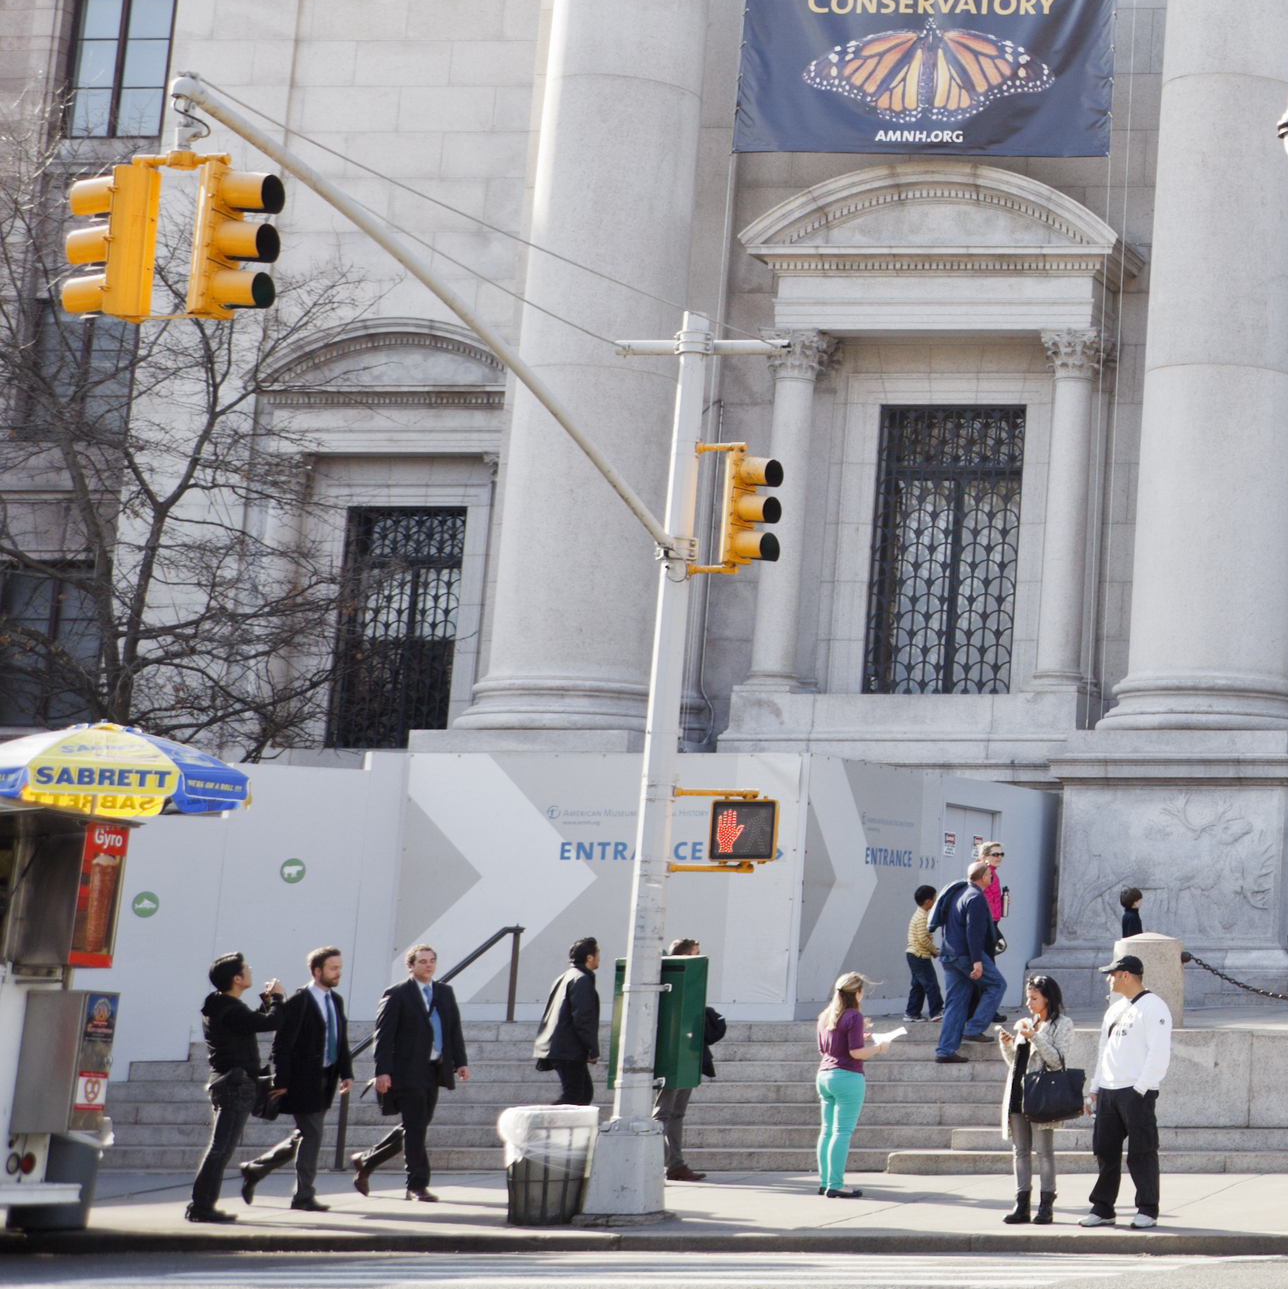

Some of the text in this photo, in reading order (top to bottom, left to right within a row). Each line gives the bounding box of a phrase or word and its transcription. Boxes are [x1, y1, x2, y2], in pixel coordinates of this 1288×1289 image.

[874, 130, 964, 143] AMNH.ORG
[35, 766, 172, 788] SABRETT
[563, 810, 604, 818] AMERICAN
[605, 809, 637, 818] MUSEUM
[679, 810, 709, 818] HISTORY
[95, 828, 123, 849] Gyro
[865, 847, 912, 868] ENTRANCE
